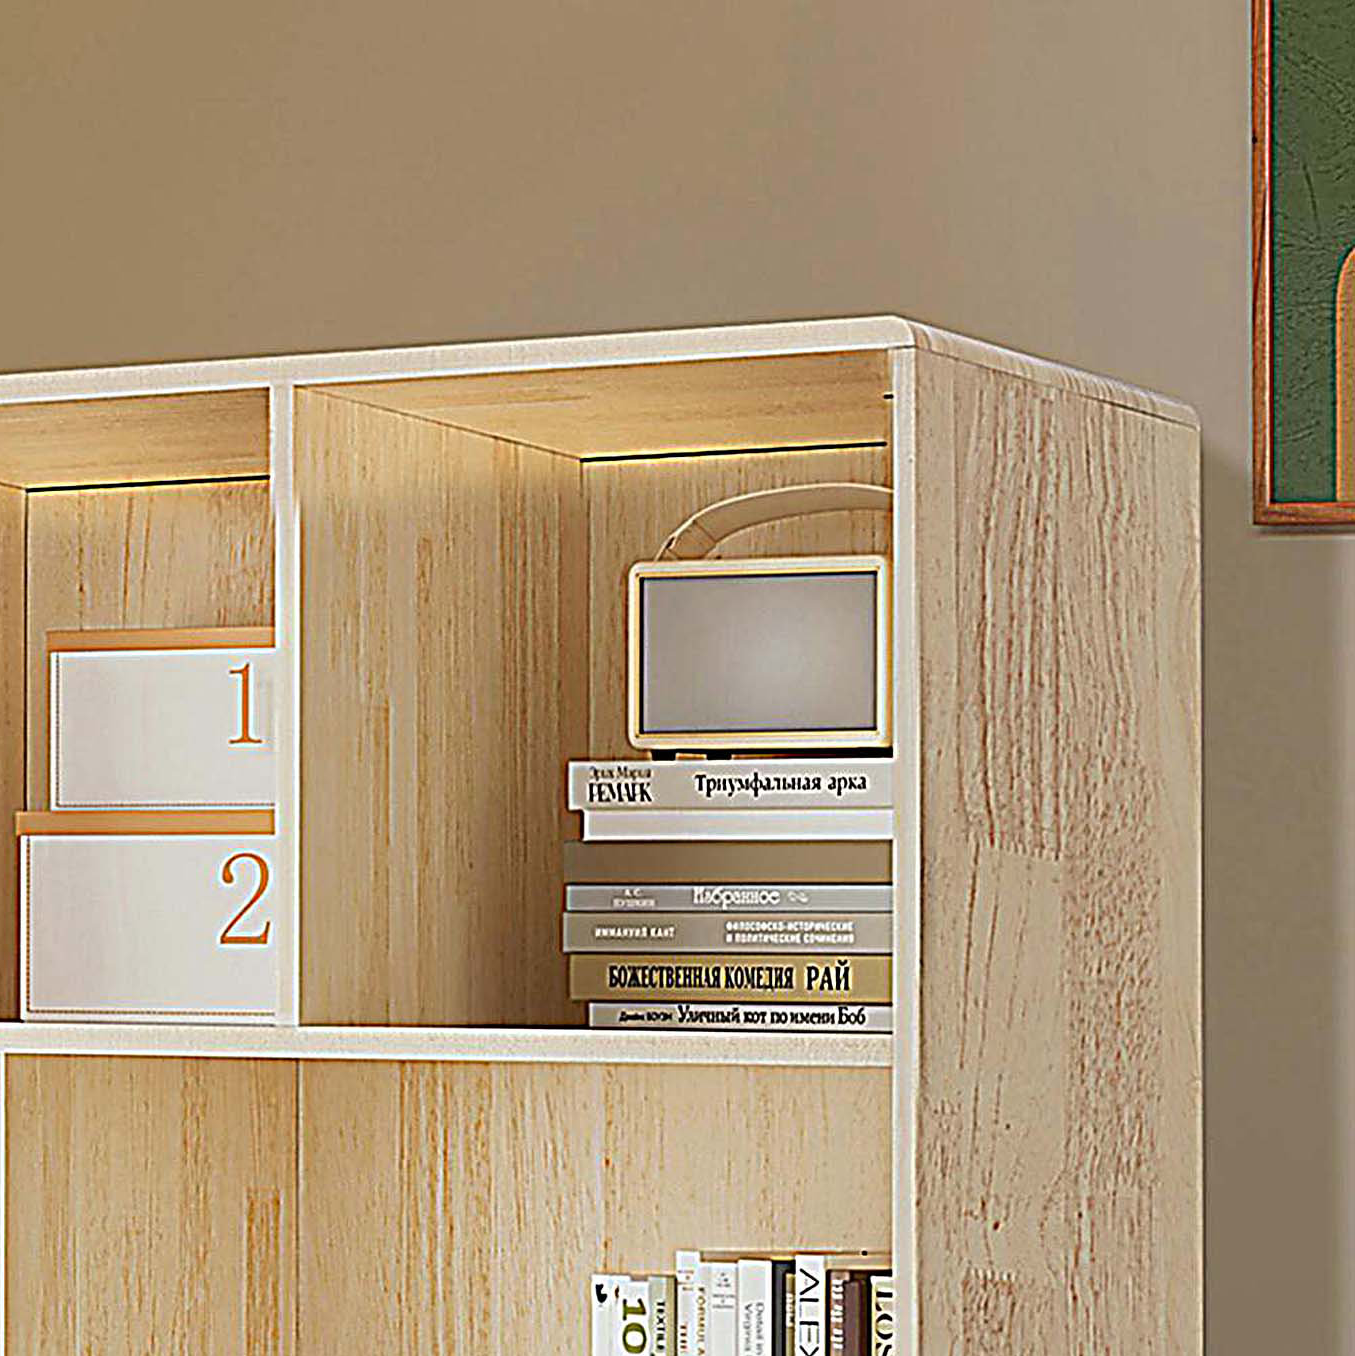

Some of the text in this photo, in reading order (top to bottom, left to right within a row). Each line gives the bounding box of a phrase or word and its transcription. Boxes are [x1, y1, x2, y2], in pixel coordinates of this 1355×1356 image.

[229, 663, 262, 744] 1
[588, 782, 652, 802] РЕМАРК
[695, 772, 867, 797] Триумфальная арка
[220, 853, 271, 945] 2
[693, 886, 781, 910] Избранное
[608, 960, 851, 991] БОЖЕСТВЕННАЯ КОМЕДИЯ РАЙ
[677, 1005, 740, 1024] Уличный
[743, 1011, 766, 1024] кот
[770, 1011, 788, 1024] по
[790, 1012, 835, 1025] имени
[838, 1006, 866, 1025] Боб
